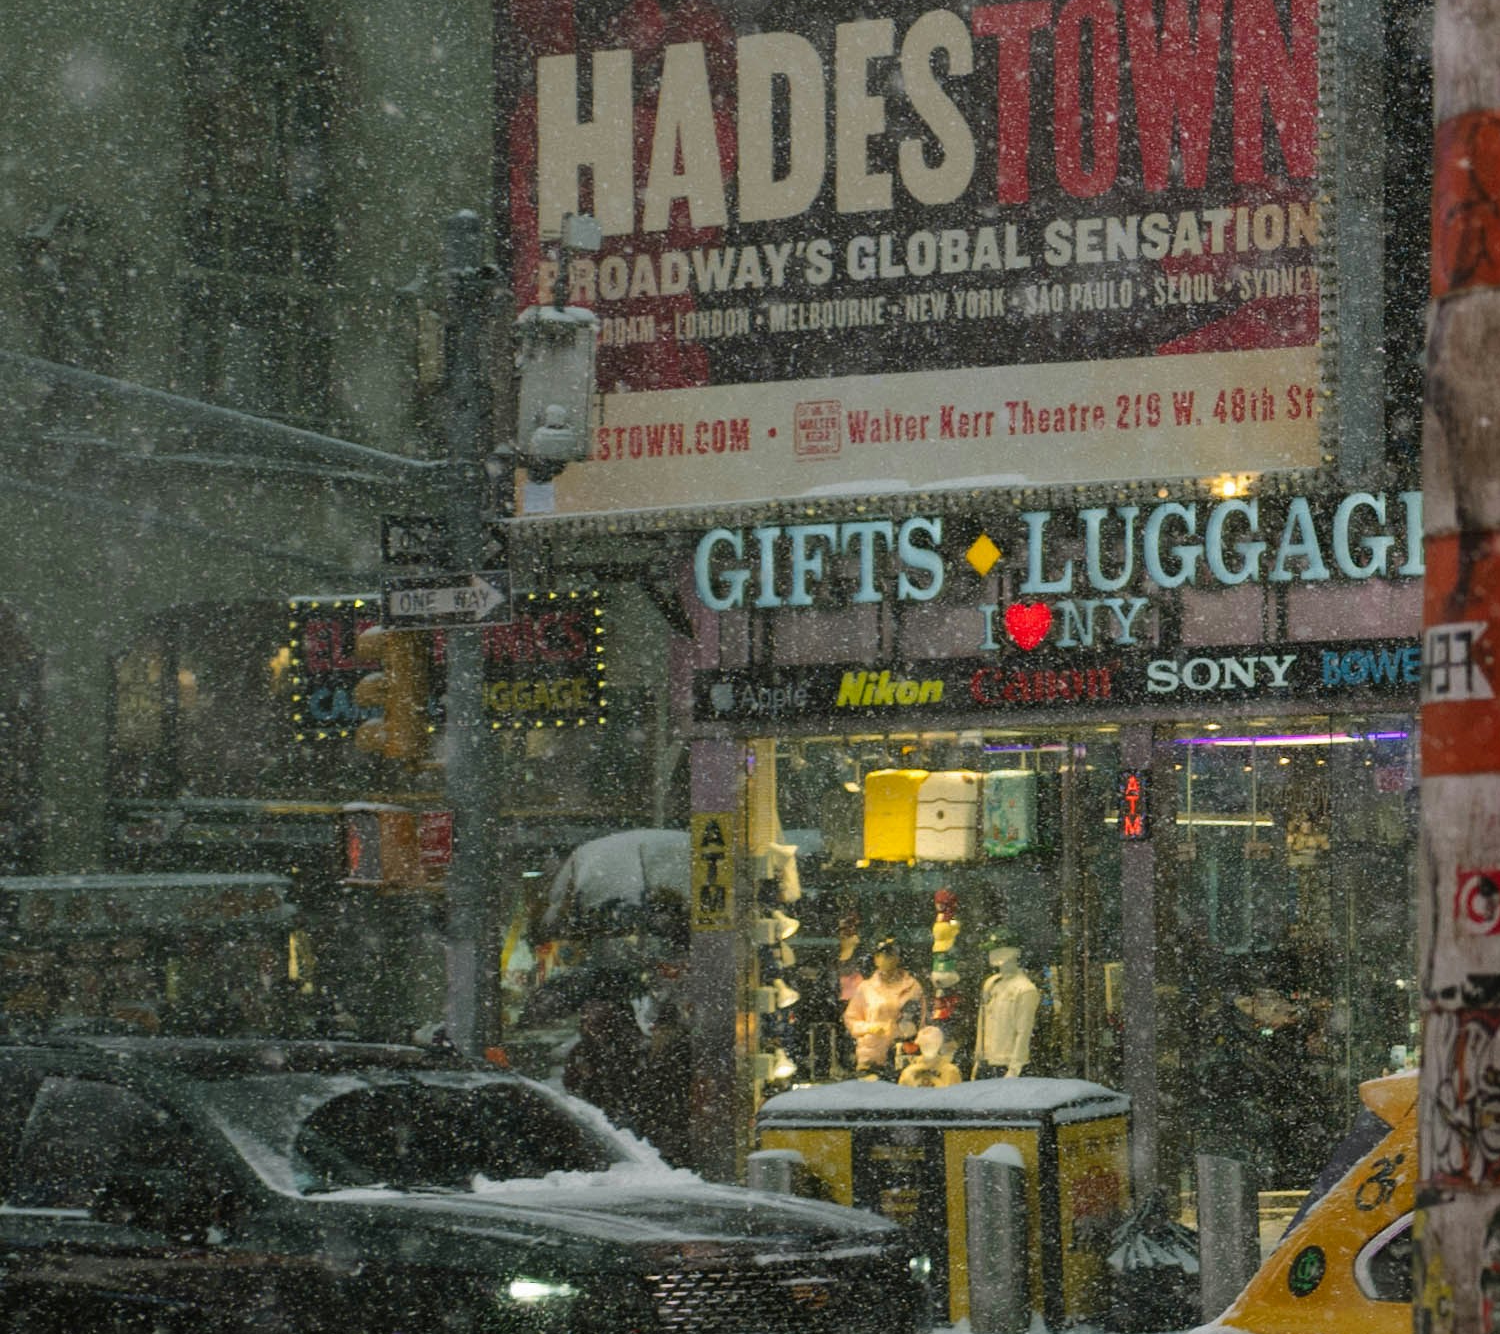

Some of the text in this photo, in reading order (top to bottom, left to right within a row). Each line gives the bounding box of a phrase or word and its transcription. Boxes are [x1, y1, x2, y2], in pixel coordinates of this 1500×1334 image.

[845, 222, 1030, 282] GLOBAL
[1043, 200, 1320, 269] SENSATION
[675, 307, 751, 345] LONDON
[768, 296, 887, 334] MELBOURNE
[905, 291, 947, 323] NEW
[953, 288, 1006, 319] YORK
[1070, 278, 1134, 313] PAULO
[1154, 274, 1219, 307] SEOUL
[1239, 267, 1320, 300] SYDNEY
[589, 418, 751, 463] STOWN.COM
[847, 408, 931, 445] Walter
[939, 403, 995, 439] Kerr
[1004, 400, 1106, 436] Theatre
[1172, 389, 1202, 426] W.
[1212, 387, 1276, 424] 48th
[694, 516, 945, 612] GIFTS
[402, 588, 490, 615] ONE WAY
[978, 597, 1150, 652] I NY
[740, 686, 808, 711] Apple
[836, 670, 944, 708] Nikon
[969, 663, 1117, 706] Canon
[1146, 654, 1298, 693] SONY
[1124, 773, 1144, 837] ATM
[701, 819, 726, 914] ATM
